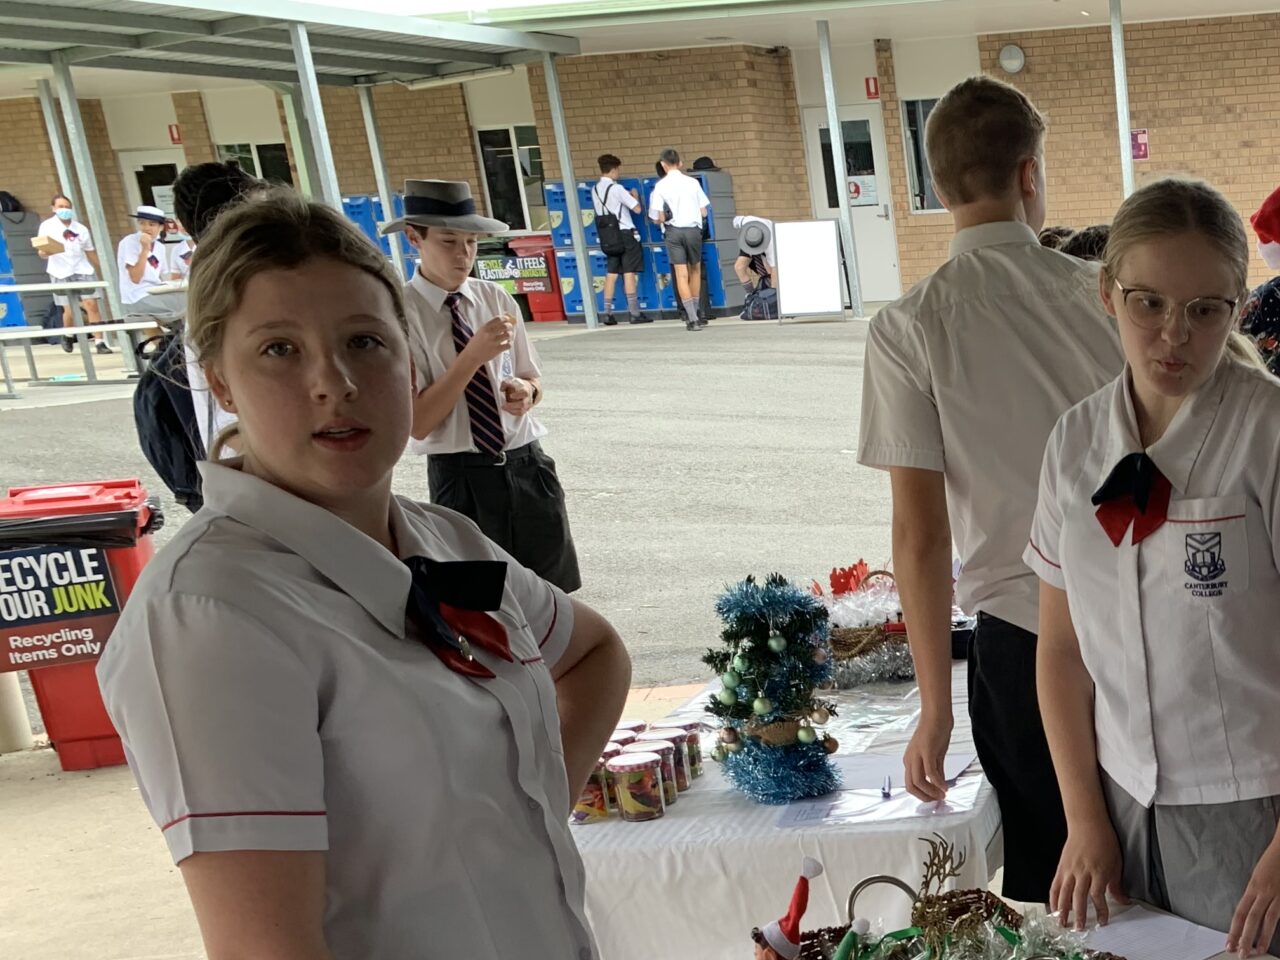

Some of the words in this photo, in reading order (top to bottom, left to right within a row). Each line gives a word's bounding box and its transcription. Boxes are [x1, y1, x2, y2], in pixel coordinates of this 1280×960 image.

[516, 258, 523, 269] IT
[524, 257, 546, 269] FEELS
[0, 548, 104, 592] ECYCLE
[1184, 581, 1228, 590] CANTERBURY
[1192, 589, 1223, 598] COLLEGE
[0, 589, 50, 622] OUR
[52, 581, 112, 615] JUNK
[9, 626, 94, 649] Recycling
[9, 646, 58, 664] Items
[61, 639, 101, 656] Only
